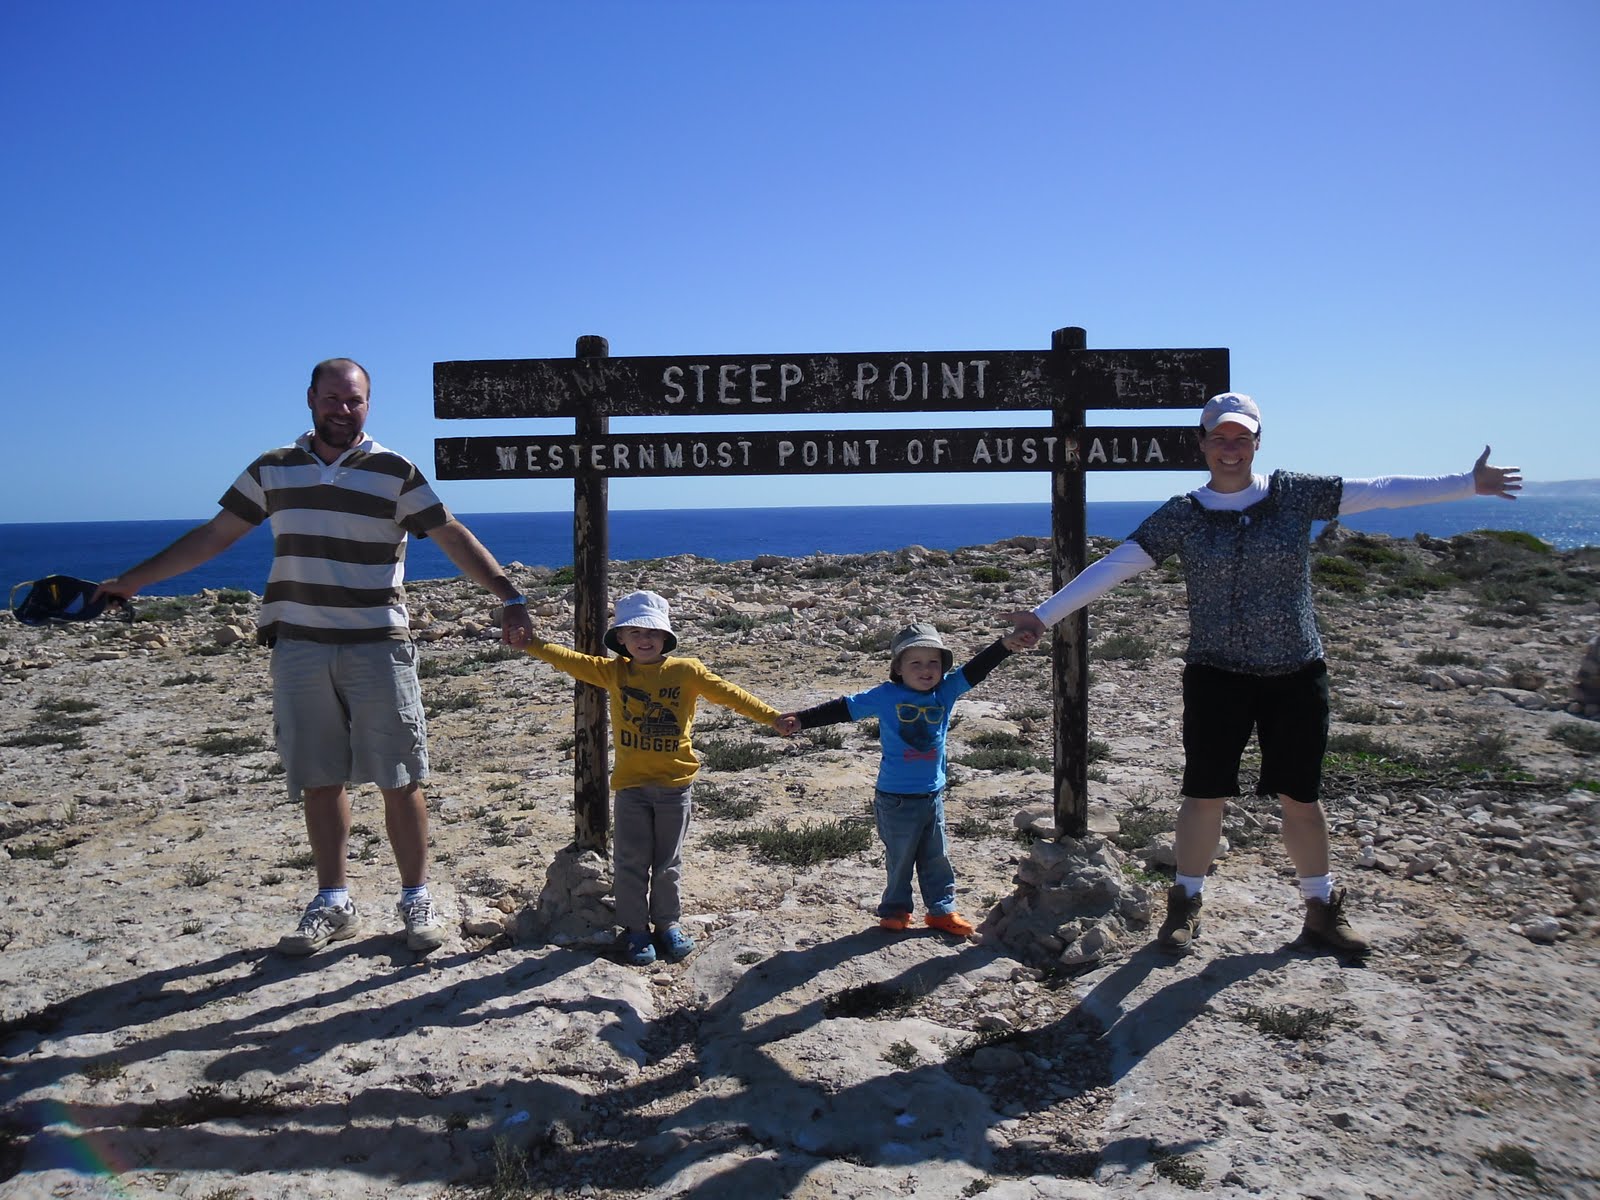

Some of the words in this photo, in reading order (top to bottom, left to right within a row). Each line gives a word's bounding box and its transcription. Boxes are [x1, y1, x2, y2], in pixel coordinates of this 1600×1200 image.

[662, 364, 803, 404] STEEP
[856, 359, 990, 401] POINT
[495, 441, 753, 472] WESTERNMOST
[778, 439, 880, 467] POINT
[907, 438, 949, 465] OF
[972, 436, 1166, 464] AUSTRALIA
[659, 686, 680, 699] DIG
[621, 730, 680, 752] DIGGER
